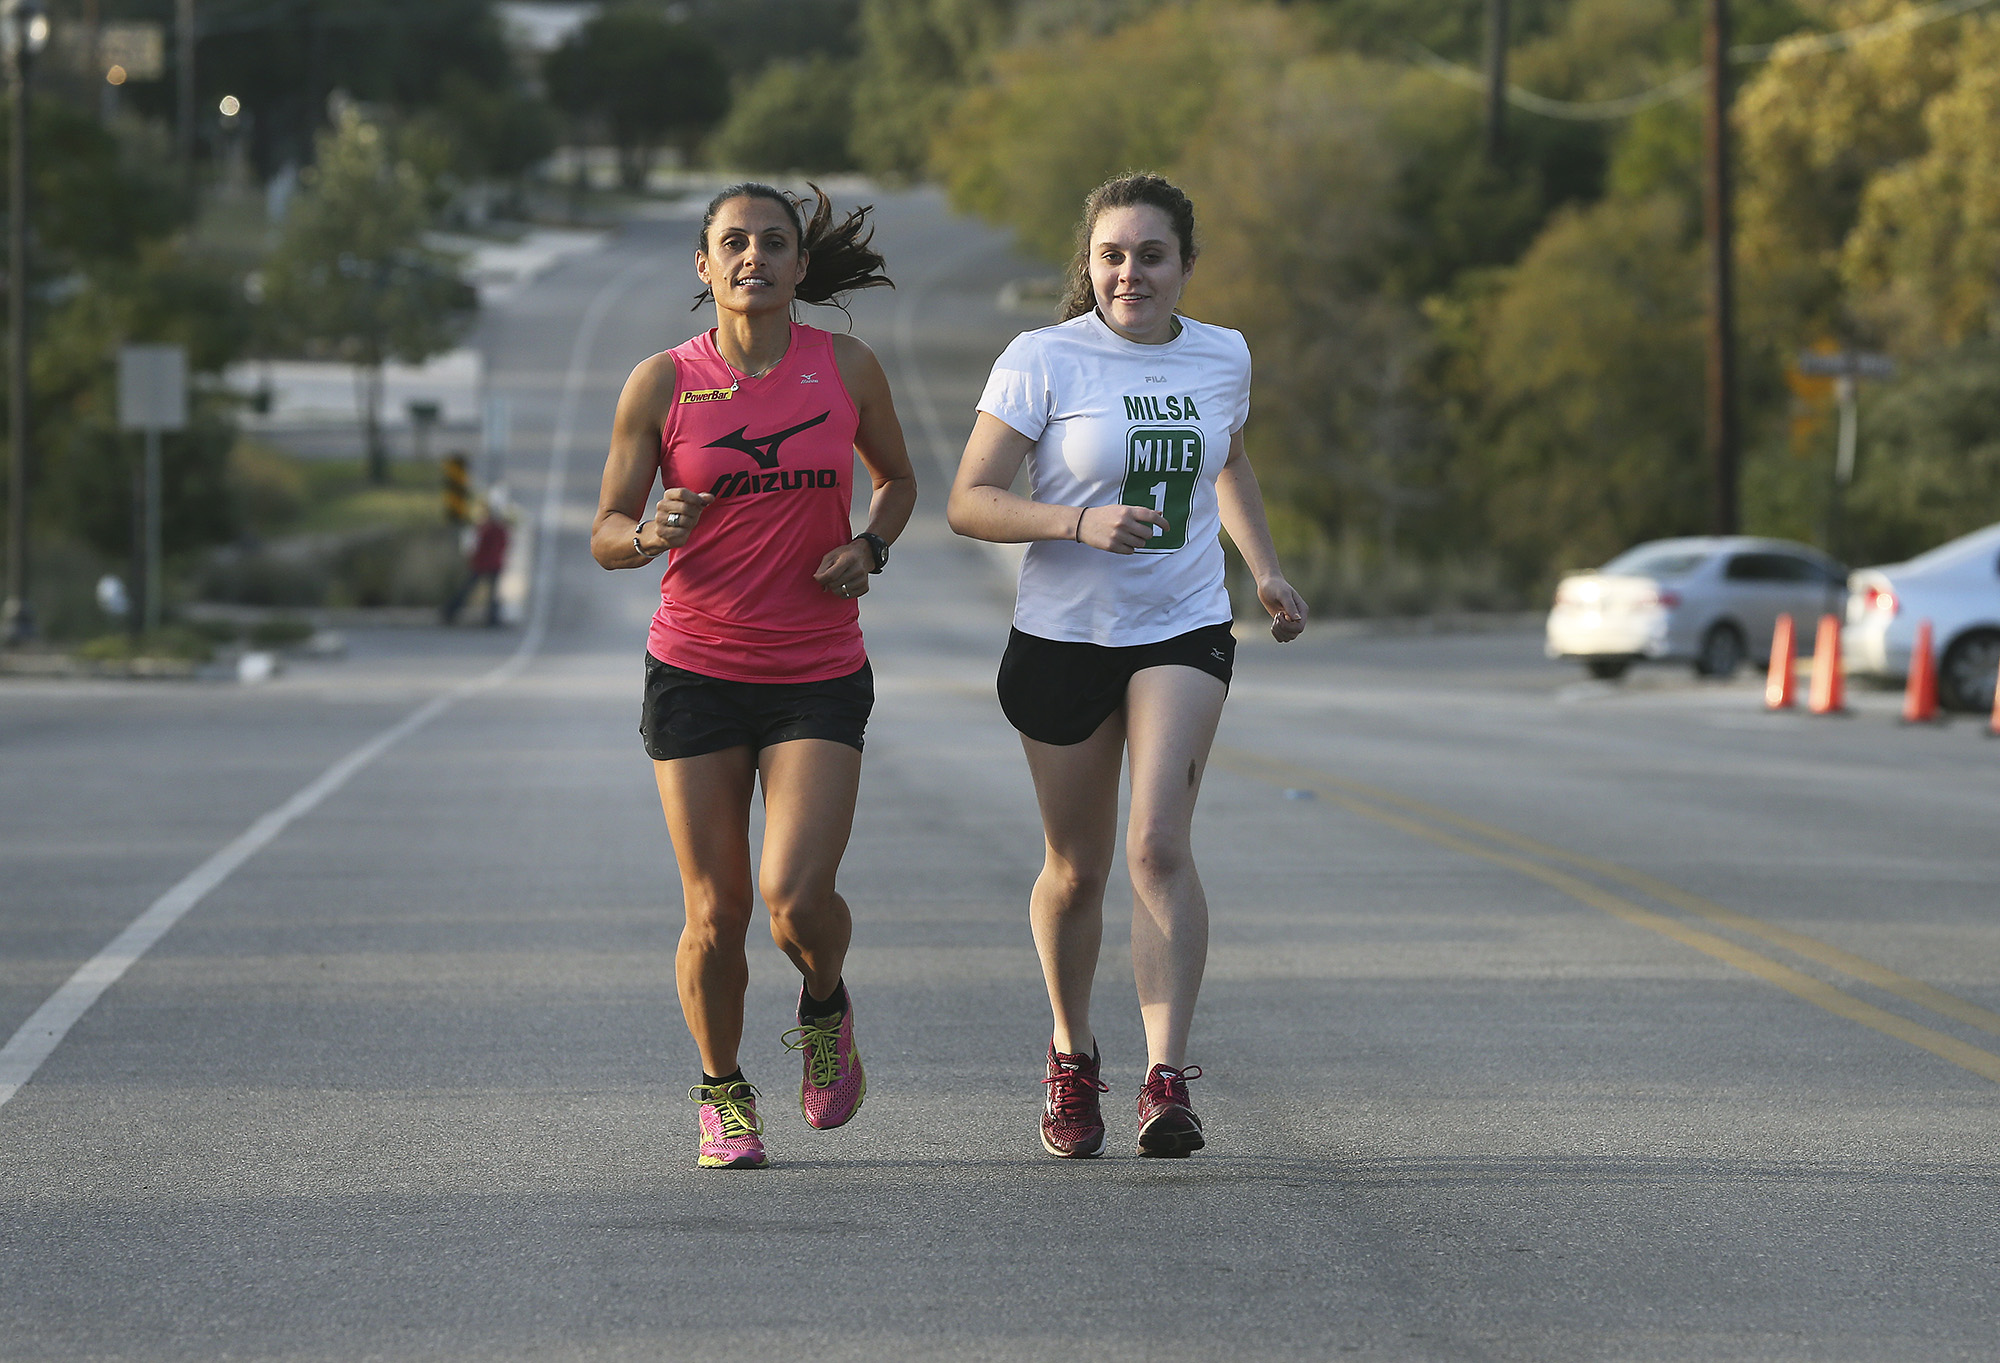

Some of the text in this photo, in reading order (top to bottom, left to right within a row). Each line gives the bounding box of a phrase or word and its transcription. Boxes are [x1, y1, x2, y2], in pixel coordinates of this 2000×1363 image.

[1145, 375, 1167, 383] FILA
[684, 390, 729, 402] PowerBar
[1123, 396, 1201, 421] MILSA
[1133, 439, 1196, 472] MILE
[1149, 481, 1168, 537] 1
